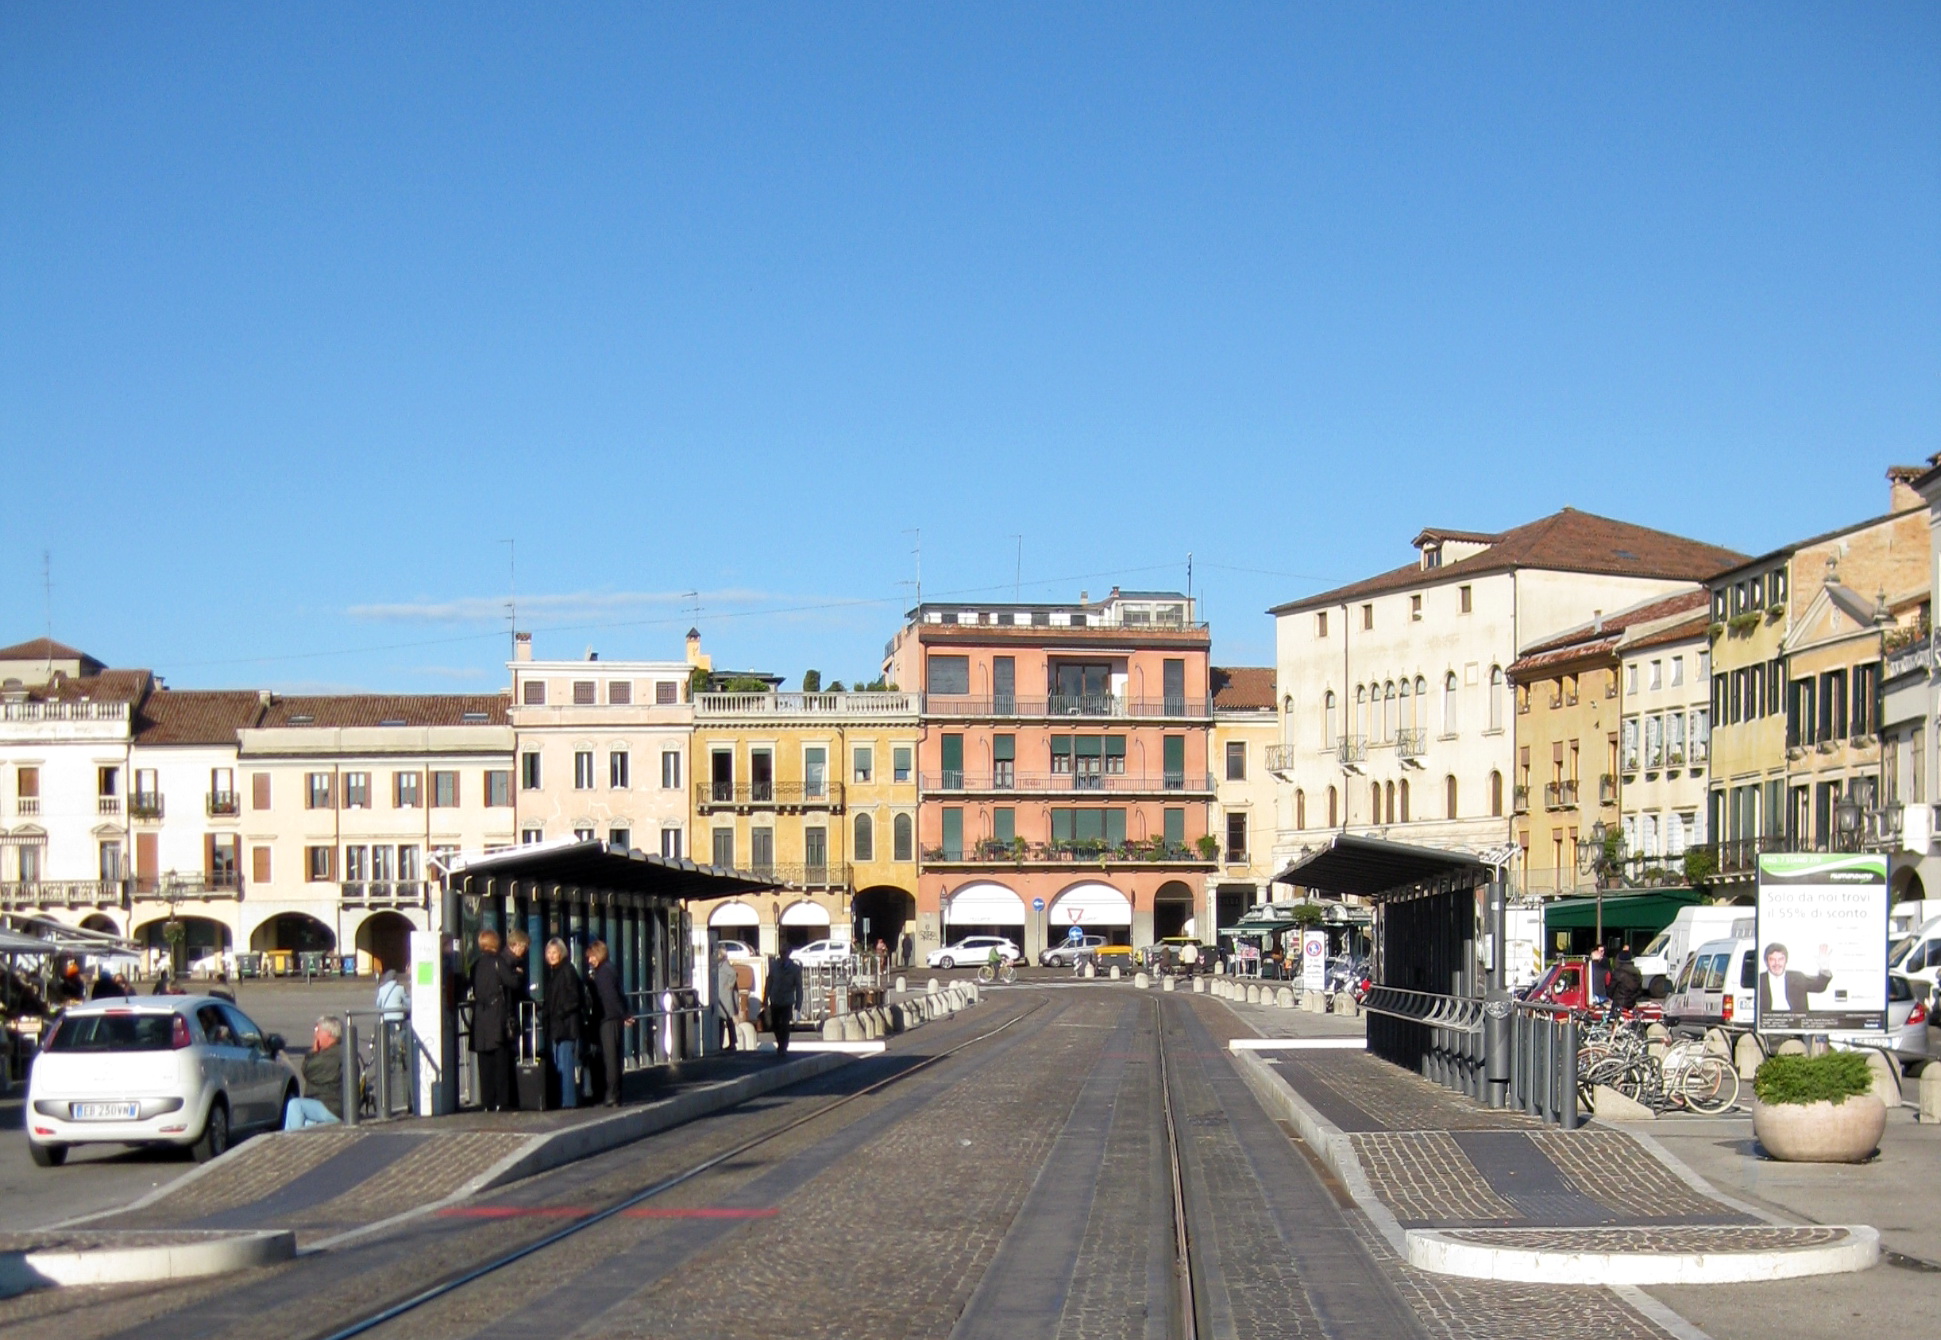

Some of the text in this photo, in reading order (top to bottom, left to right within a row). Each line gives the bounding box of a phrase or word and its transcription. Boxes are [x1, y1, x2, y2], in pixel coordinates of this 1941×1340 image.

[1767, 891, 1870, 903] Solo da noi trovi
[1767, 908, 1774, 919] il
[1779, 908, 1806, 919] 55%
[1810, 908, 1823, 919] di
